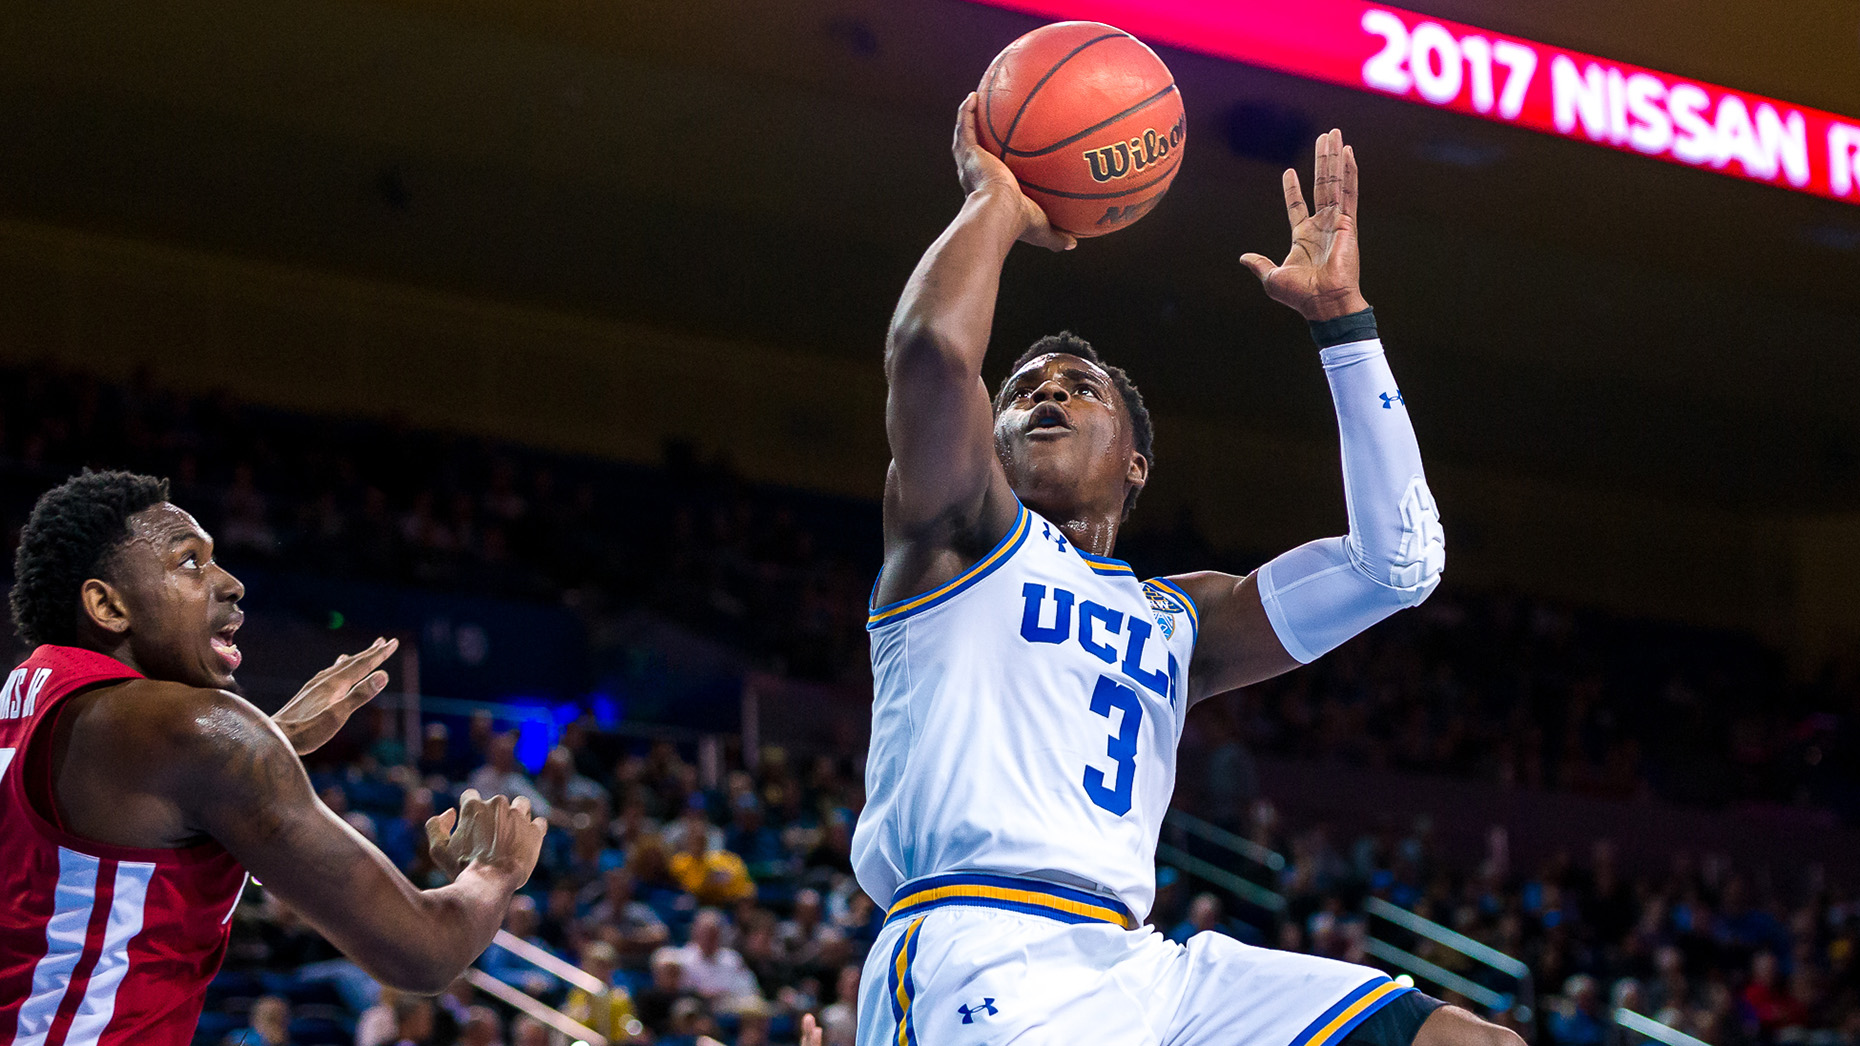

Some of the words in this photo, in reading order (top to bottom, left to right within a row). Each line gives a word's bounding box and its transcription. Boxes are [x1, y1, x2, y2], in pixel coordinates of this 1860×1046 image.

[1361, 9, 1538, 119] 2017
[1551, 54, 1811, 188] NISSAN
[1083, 674, 1143, 817] 3
